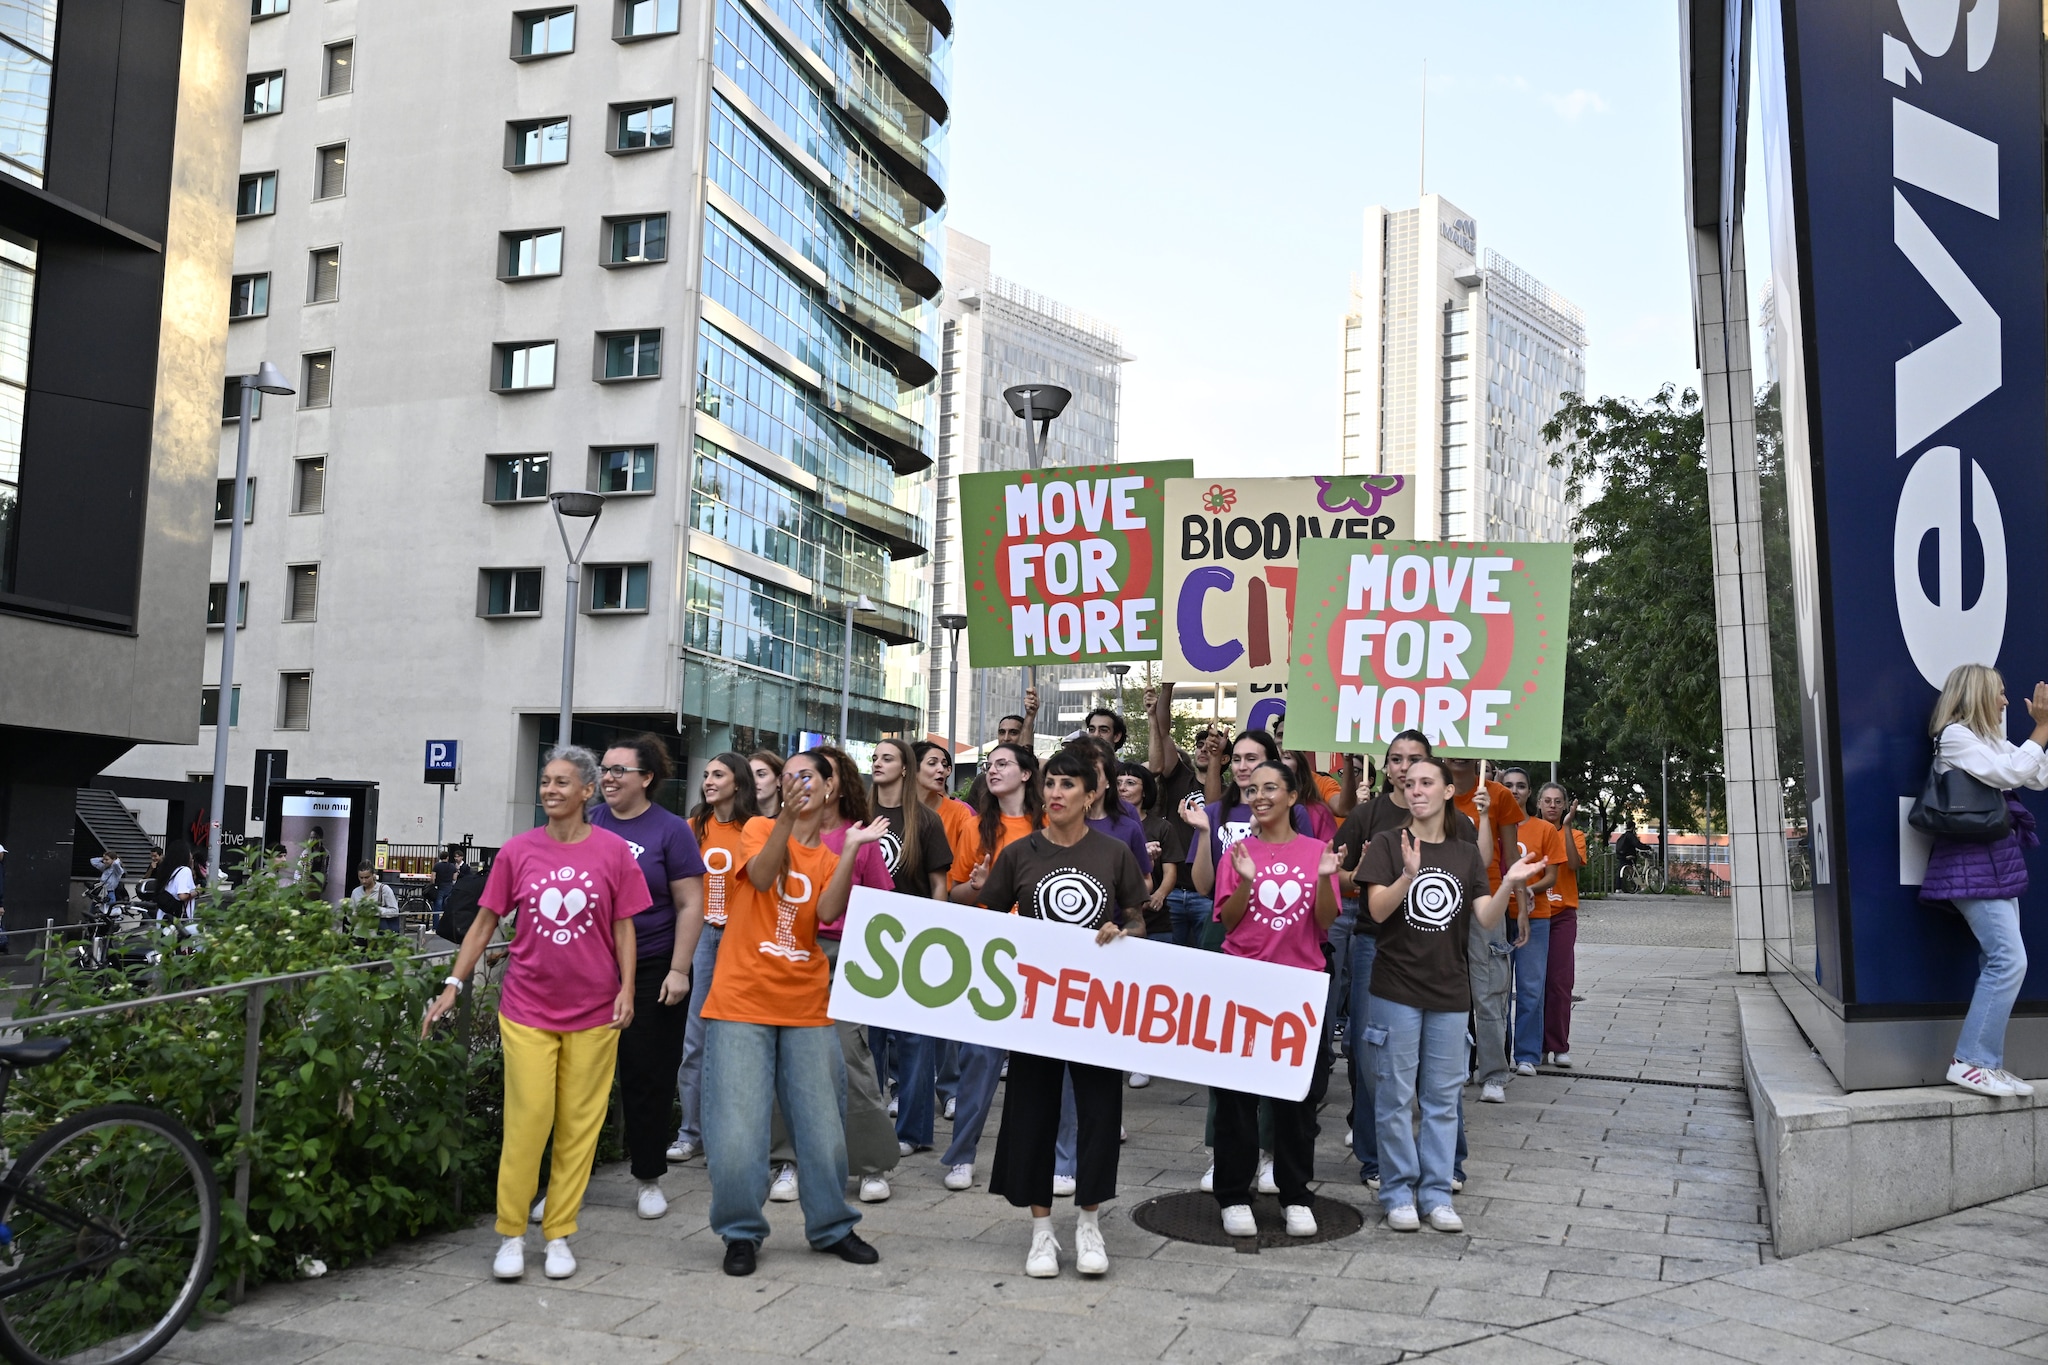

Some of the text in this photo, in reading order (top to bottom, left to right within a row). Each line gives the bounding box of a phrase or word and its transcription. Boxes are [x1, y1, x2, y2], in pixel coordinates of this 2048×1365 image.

[1005, 476, 1147, 537] MOVE
[1008, 540, 1117, 597] FOR
[1347, 554, 1514, 615] MOVE
[1012, 598, 1158, 657] MORE
[1341, 619, 1472, 680] FOR
[1335, 684, 1512, 750] MORE
[430, 743, 447, 767] P
[220, 830, 244, 845] ctive
[844, 913, 1317, 1067] SOSTENIBILITÀ
